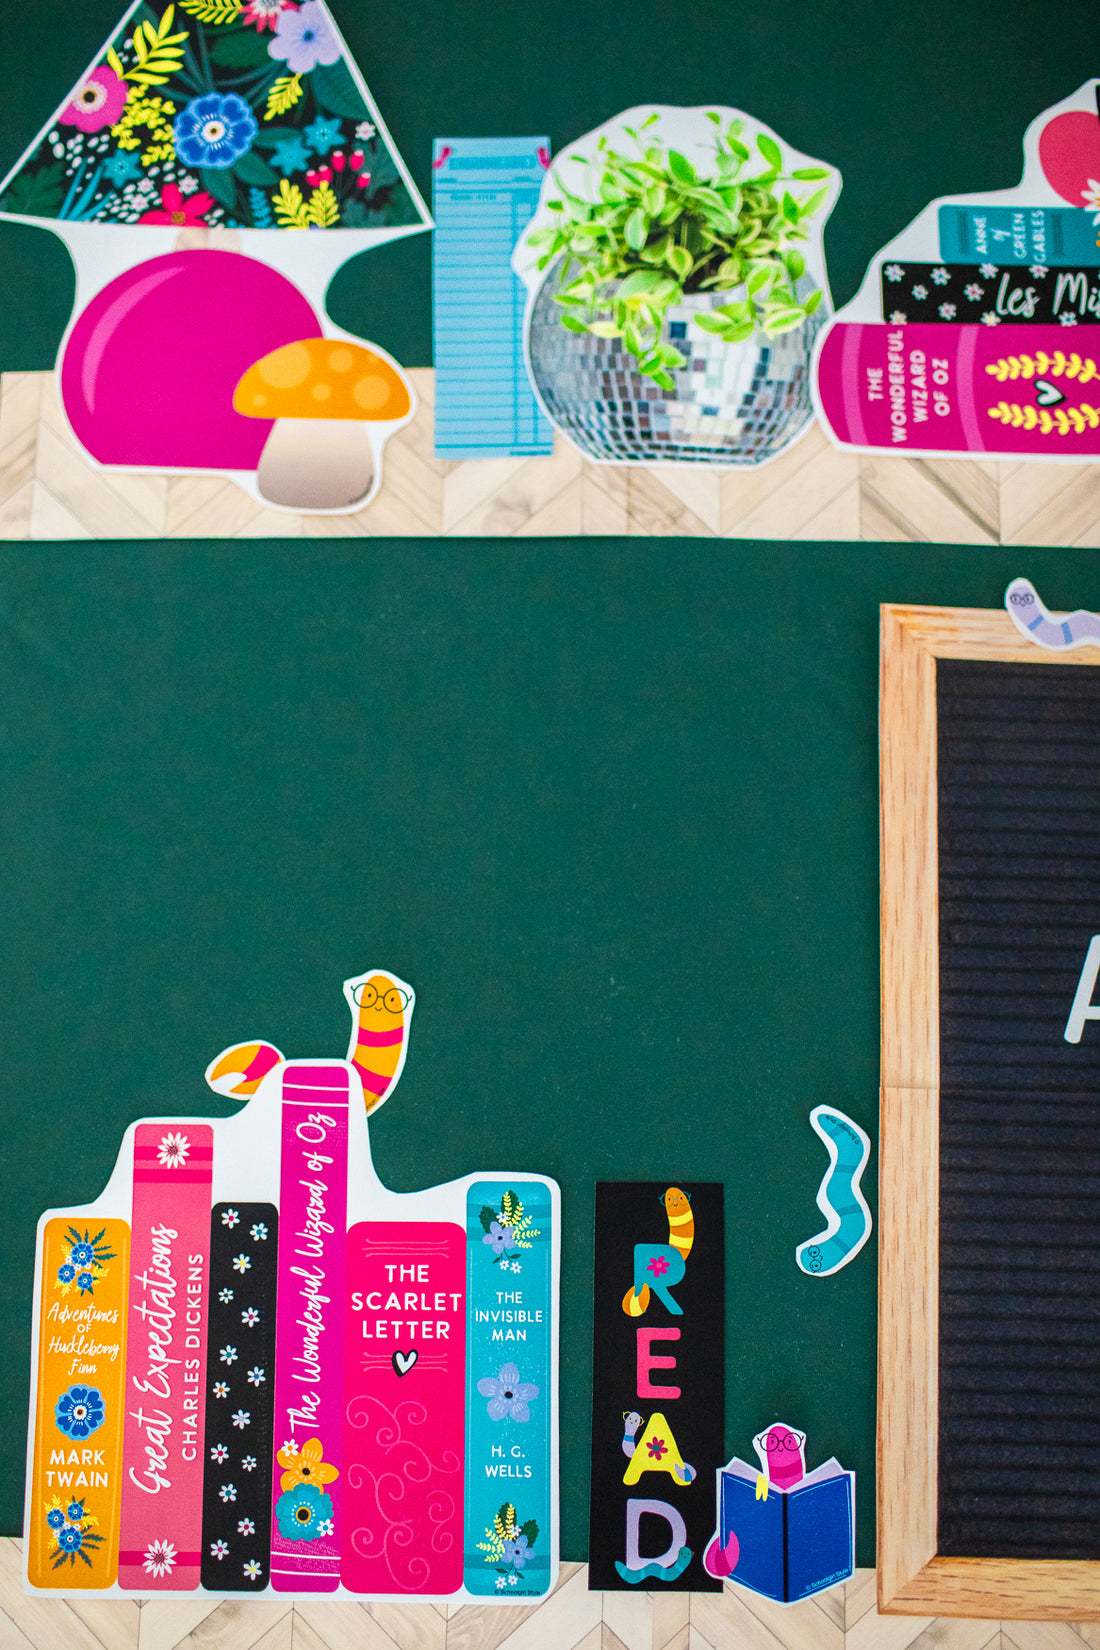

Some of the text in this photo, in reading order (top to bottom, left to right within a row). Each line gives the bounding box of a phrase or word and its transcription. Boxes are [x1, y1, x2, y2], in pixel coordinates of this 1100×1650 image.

[973, 214, 988, 255] ANNE
[989, 227, 1012, 242] of
[1012, 212, 1028, 259] GREEN
[1031, 208, 1046, 263] GABLES
[866, 367, 885, 402] THE
[887, 329, 907, 443] WONDERFUL
[909, 349, 929, 423] WIZARD
[931, 358, 951, 417] OF OZ
[287, 1110, 338, 1434] The Wonderful Wizard of Oz
[384, 1264, 430, 1283] THE
[351, 1292, 462, 1312] SCARLET
[496, 1291, 523, 1304] THE
[46, 1301, 120, 1324] Adventures
[475, 1309, 543, 1323] INVISIBLE
[77, 1323, 92, 1333] OF
[362, 1320, 450, 1340] LETTER
[491, 1329, 527, 1341] MAN
[47, 1334, 120, 1362] Huckleberry
[181, 1253, 204, 1462] CHARLES DICKENS
[67, 1358, 98, 1376] Finn
[128, 1223, 183, 1495] Great Expectations
[623, 1243, 693, 1572] READ
[50, 1449, 105, 1466] MARK
[491, 1445, 526, 1458] H. G.
[45, 1471, 109, 1488] TWAIN
[485, 1465, 532, 1478] WELLS
